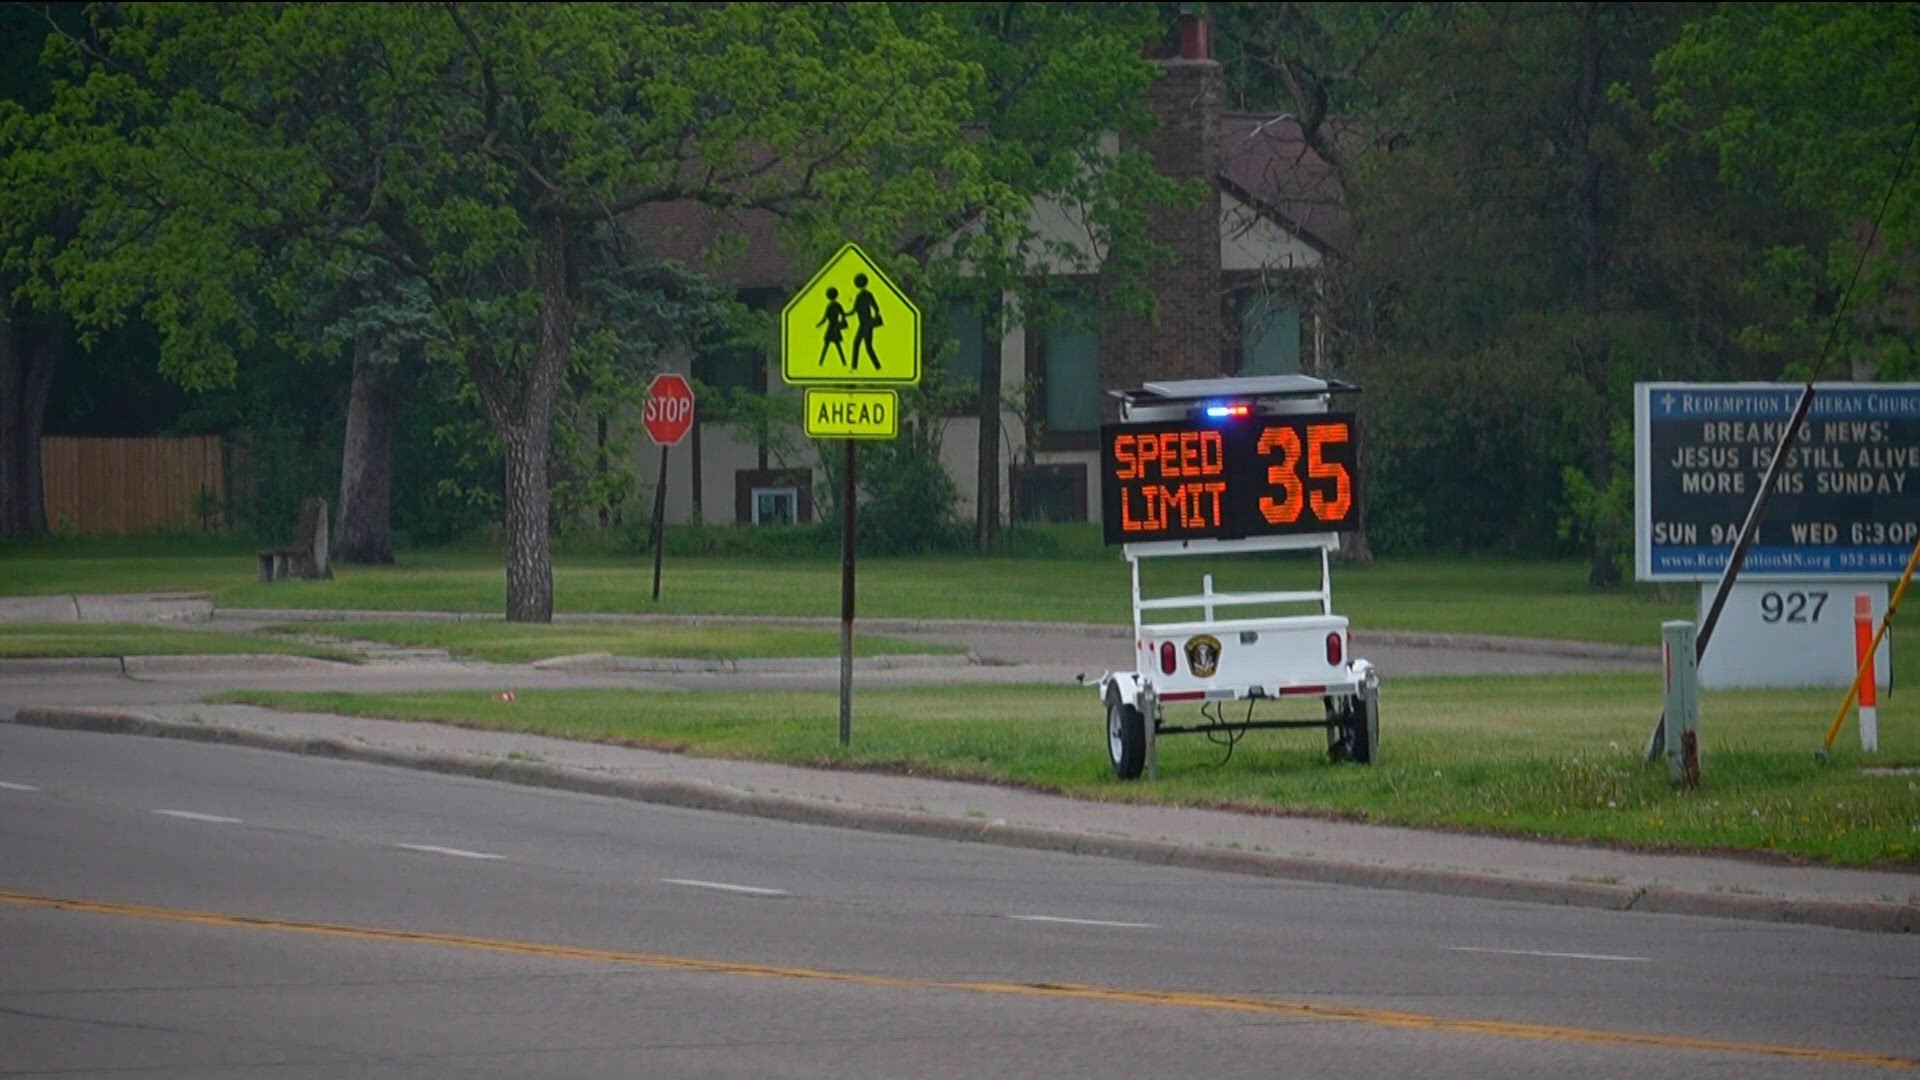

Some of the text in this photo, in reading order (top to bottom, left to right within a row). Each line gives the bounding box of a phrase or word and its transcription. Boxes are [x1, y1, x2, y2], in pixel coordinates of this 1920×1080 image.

[646, 397, 690, 422] STOP
[818, 402, 885, 424] AHEAD
[1682, 393, 1920, 413] REDEMPTION LHERAN CHURC
[1703, 421, 1889, 443] BREAKIG NEWS:
[1114, 431, 1223, 480] SPEED
[1671, 446, 1920, 469] JESUS IS STILL ALIVE
[1257, 423, 1351, 524] 35
[1681, 471, 1745, 494] MORE
[1817, 471, 1906, 494] SUNDAY
[1121, 482, 1226, 531] LIMIT
[1654, 522, 1697, 545] SUN
[1791, 522, 1839, 545] WED
[1760, 592, 1829, 624] 927
